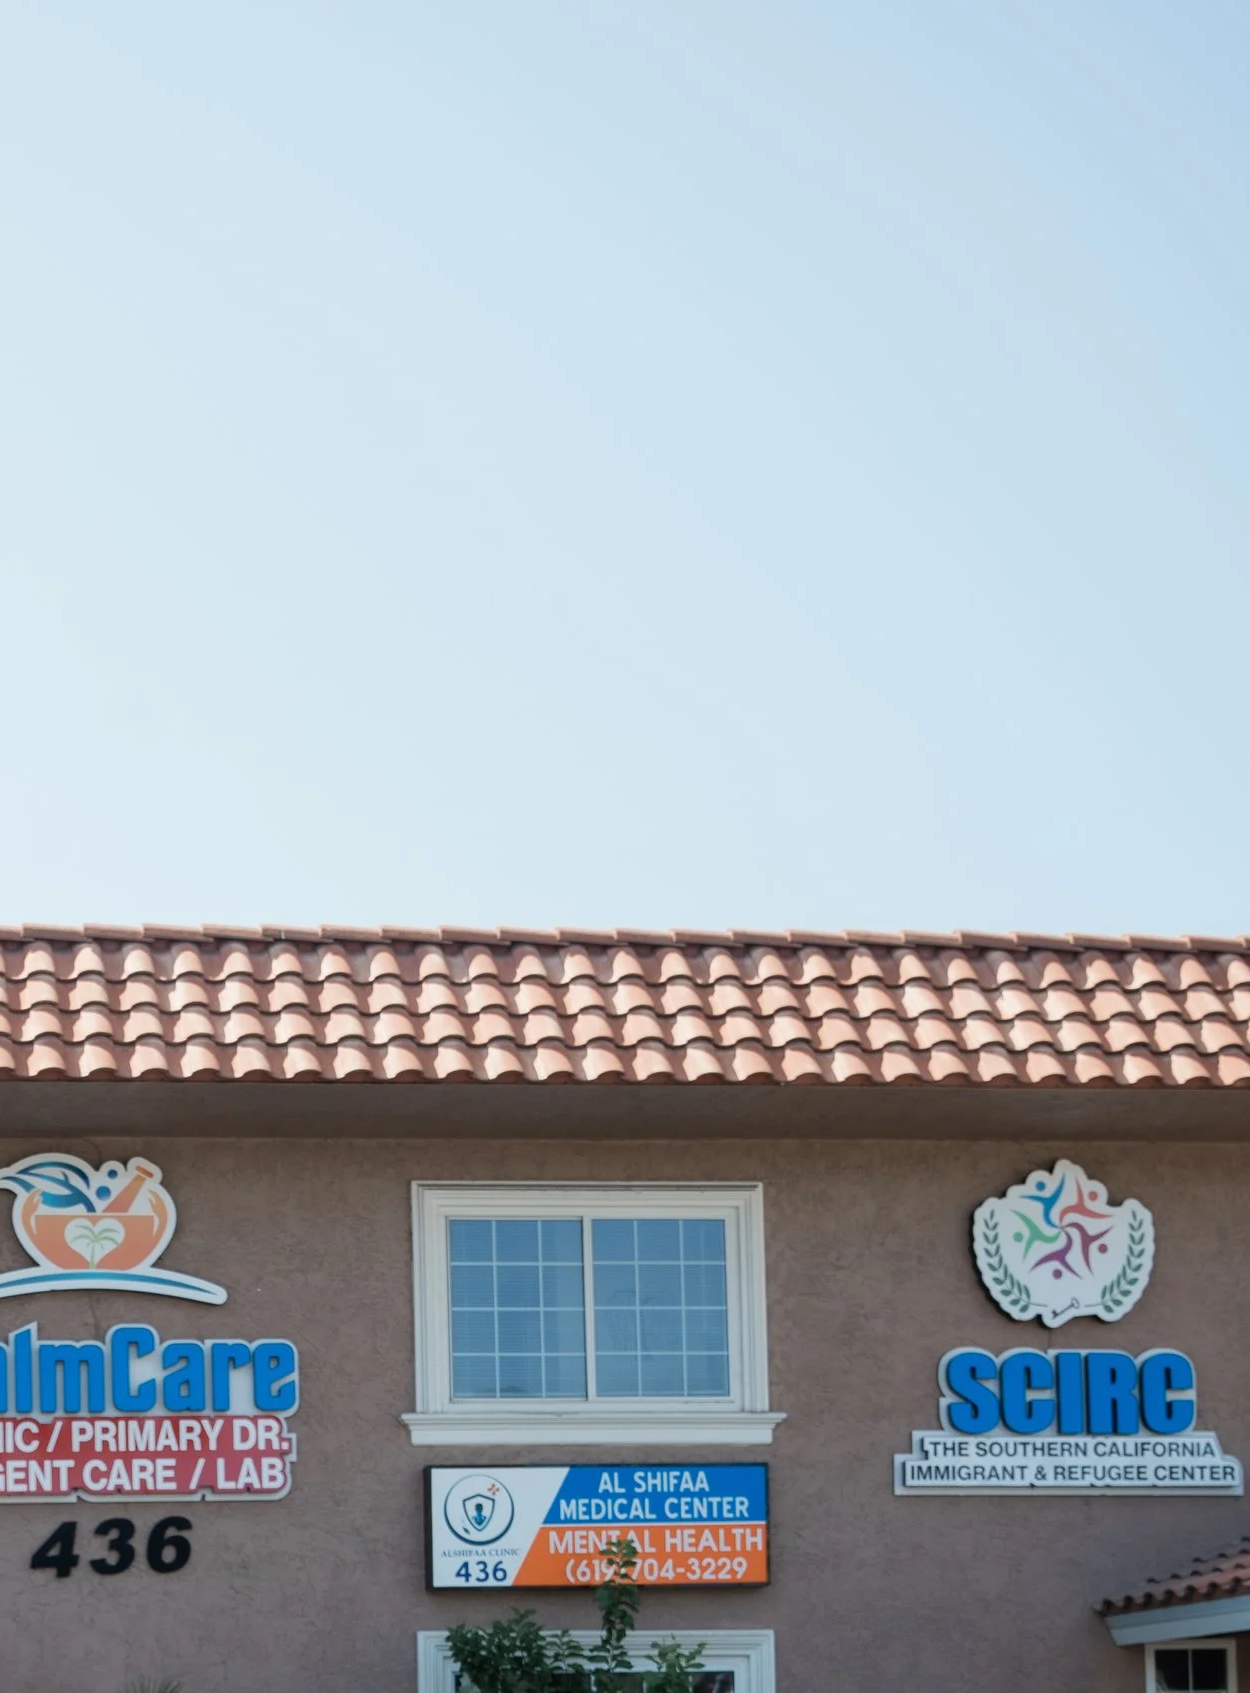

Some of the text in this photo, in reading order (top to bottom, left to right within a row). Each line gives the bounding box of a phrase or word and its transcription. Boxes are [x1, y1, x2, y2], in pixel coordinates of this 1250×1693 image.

[946, 1351, 1194, 1434] SCIRC
[46, 1419, 62, 1453] /
[71, 1418, 225, 1453] PRIMARY
[232, 1417, 291, 1452] DR.
[929, 1441, 1216, 1458] THE SOUTHERN CALIFORNIA
[82, 1458, 177, 1491] CARE
[188, 1458, 206, 1490] /
[216, 1457, 286, 1490] LAB
[598, 1471, 710, 1493] AL SHIFAA
[910, 1465, 1236, 1482] IMMIGRANT & REFUGEE CENTER
[559, 1496, 749, 1521] MEDICAL CENTER
[30, 1515, 193, 1578] 436
[441, 1547, 520, 1558] ALSHIFAA CLINIC
[549, 1528, 763, 1554] MENTAL HEALTH
[455, 1560, 507, 1583] 436
